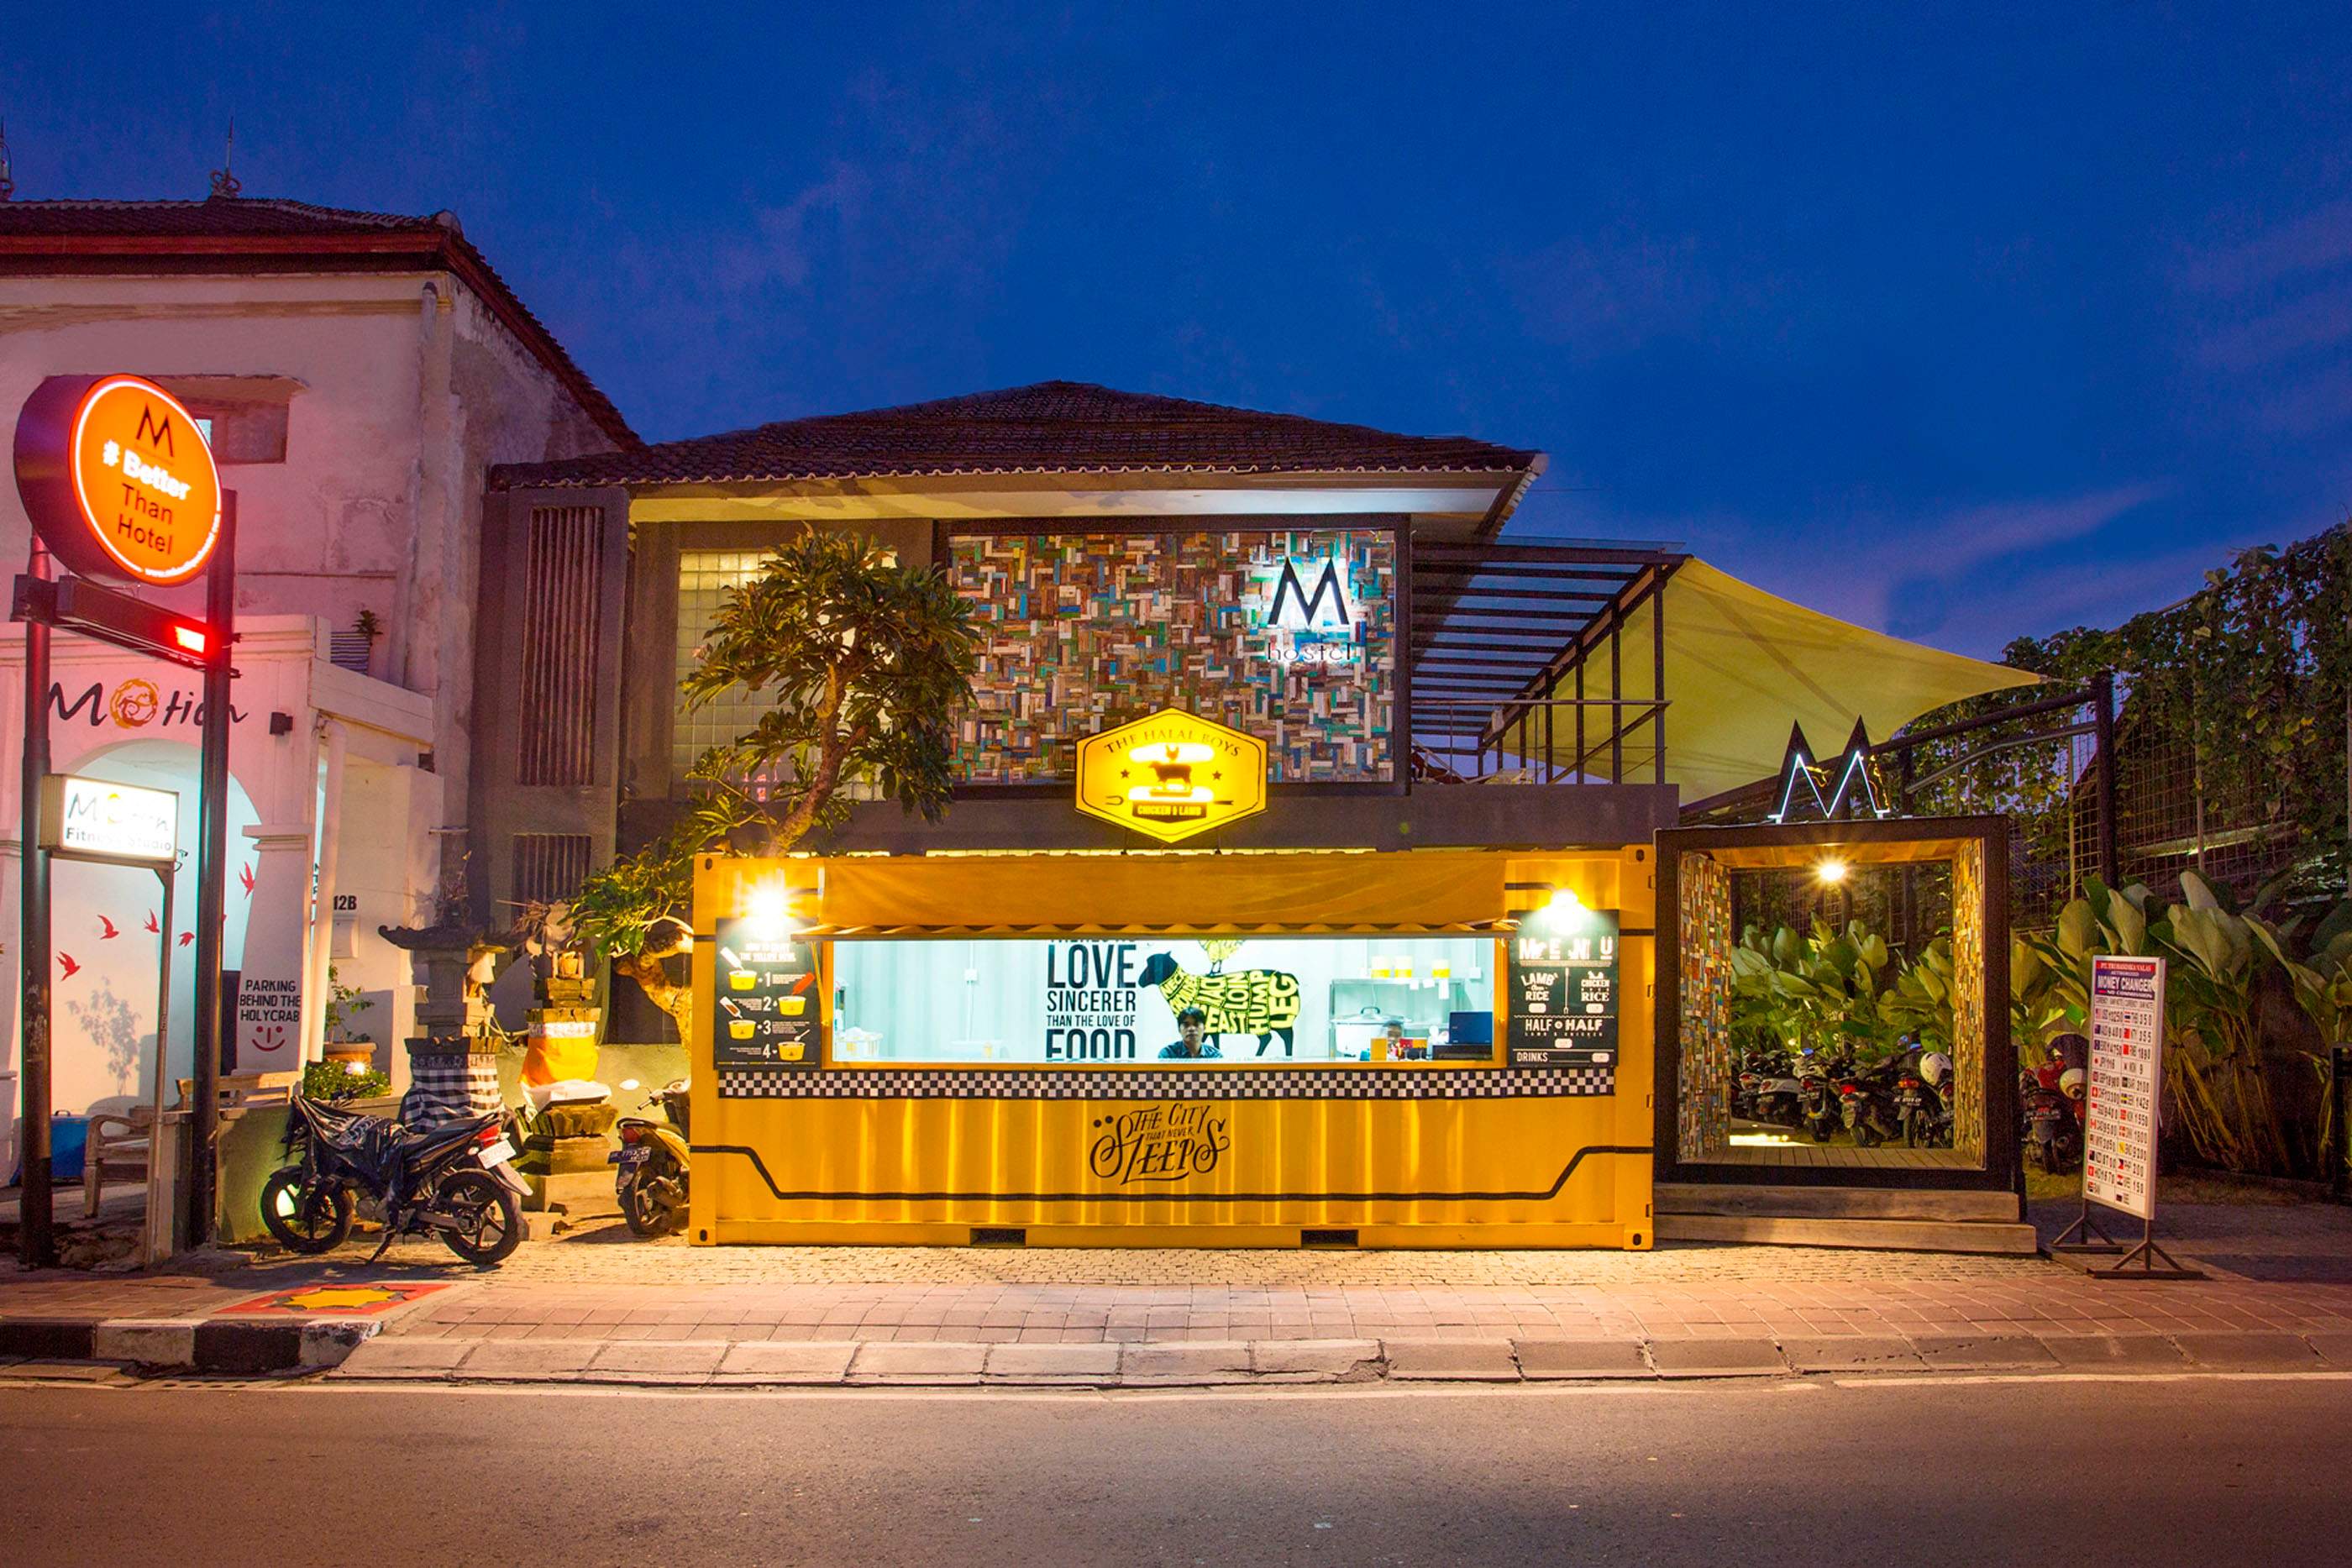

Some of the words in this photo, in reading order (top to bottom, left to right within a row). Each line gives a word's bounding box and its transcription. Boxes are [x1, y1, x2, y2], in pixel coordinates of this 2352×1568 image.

[136, 402, 174, 458] M
[122, 448, 192, 501] Better
[122, 483, 173, 525] Than
[118, 513, 173, 555] Hotel
[1268, 556, 1350, 626] M
[1267, 642, 1352, 661] hostel
[1104, 734, 1137, 753] THE
[1144, 728, 1194, 741] HALAL
[1202, 733, 1242, 757] BOYS
[1767, 715, 1890, 823] M
[1137, 805, 1171, 815] CHICKEN
[1179, 806, 1202, 816] LAMB
[1047, 944, 1137, 989] LOVE
[245, 979, 297, 992] PARKING
[764, 971, 771, 988] 1
[1520, 972, 1555, 987] LAMB
[1581, 979, 1610, 988] CHICKEN
[1224, 972, 1249, 1009] LOIN
[1525, 991, 1550, 1002] RICE
[1581, 992, 1610, 1002] RICE
[239, 994, 278, 1007] BEHIND
[281, 994, 302, 1008] THE
[763, 995, 772, 1012] 2
[1047, 990, 1136, 1012] SINCERER
[1268, 973, 1299, 1029] LEG
[240, 1009, 300, 1022] HOLYCRAB
[1047, 1015, 1072, 1027] THAN
[1075, 1015, 1094, 1027] THE
[1097, 1015, 1120, 1027] LOVE
[1123, 1015, 1136, 1027] OF
[763, 1020, 772, 1035] 3
[1525, 1019, 1552, 1031] HALF
[1565, 1019, 1603, 1031] HALF
[762, 1043, 771, 1058] 4
[1046, 1028, 1136, 1058] FOOD
[1516, 1051, 1548, 1062] DRINKS
[1130, 1104, 1163, 1132] THE
[1168, 1103, 1211, 1134] CITY
[1168, 1126, 1194, 1138] NEVER
